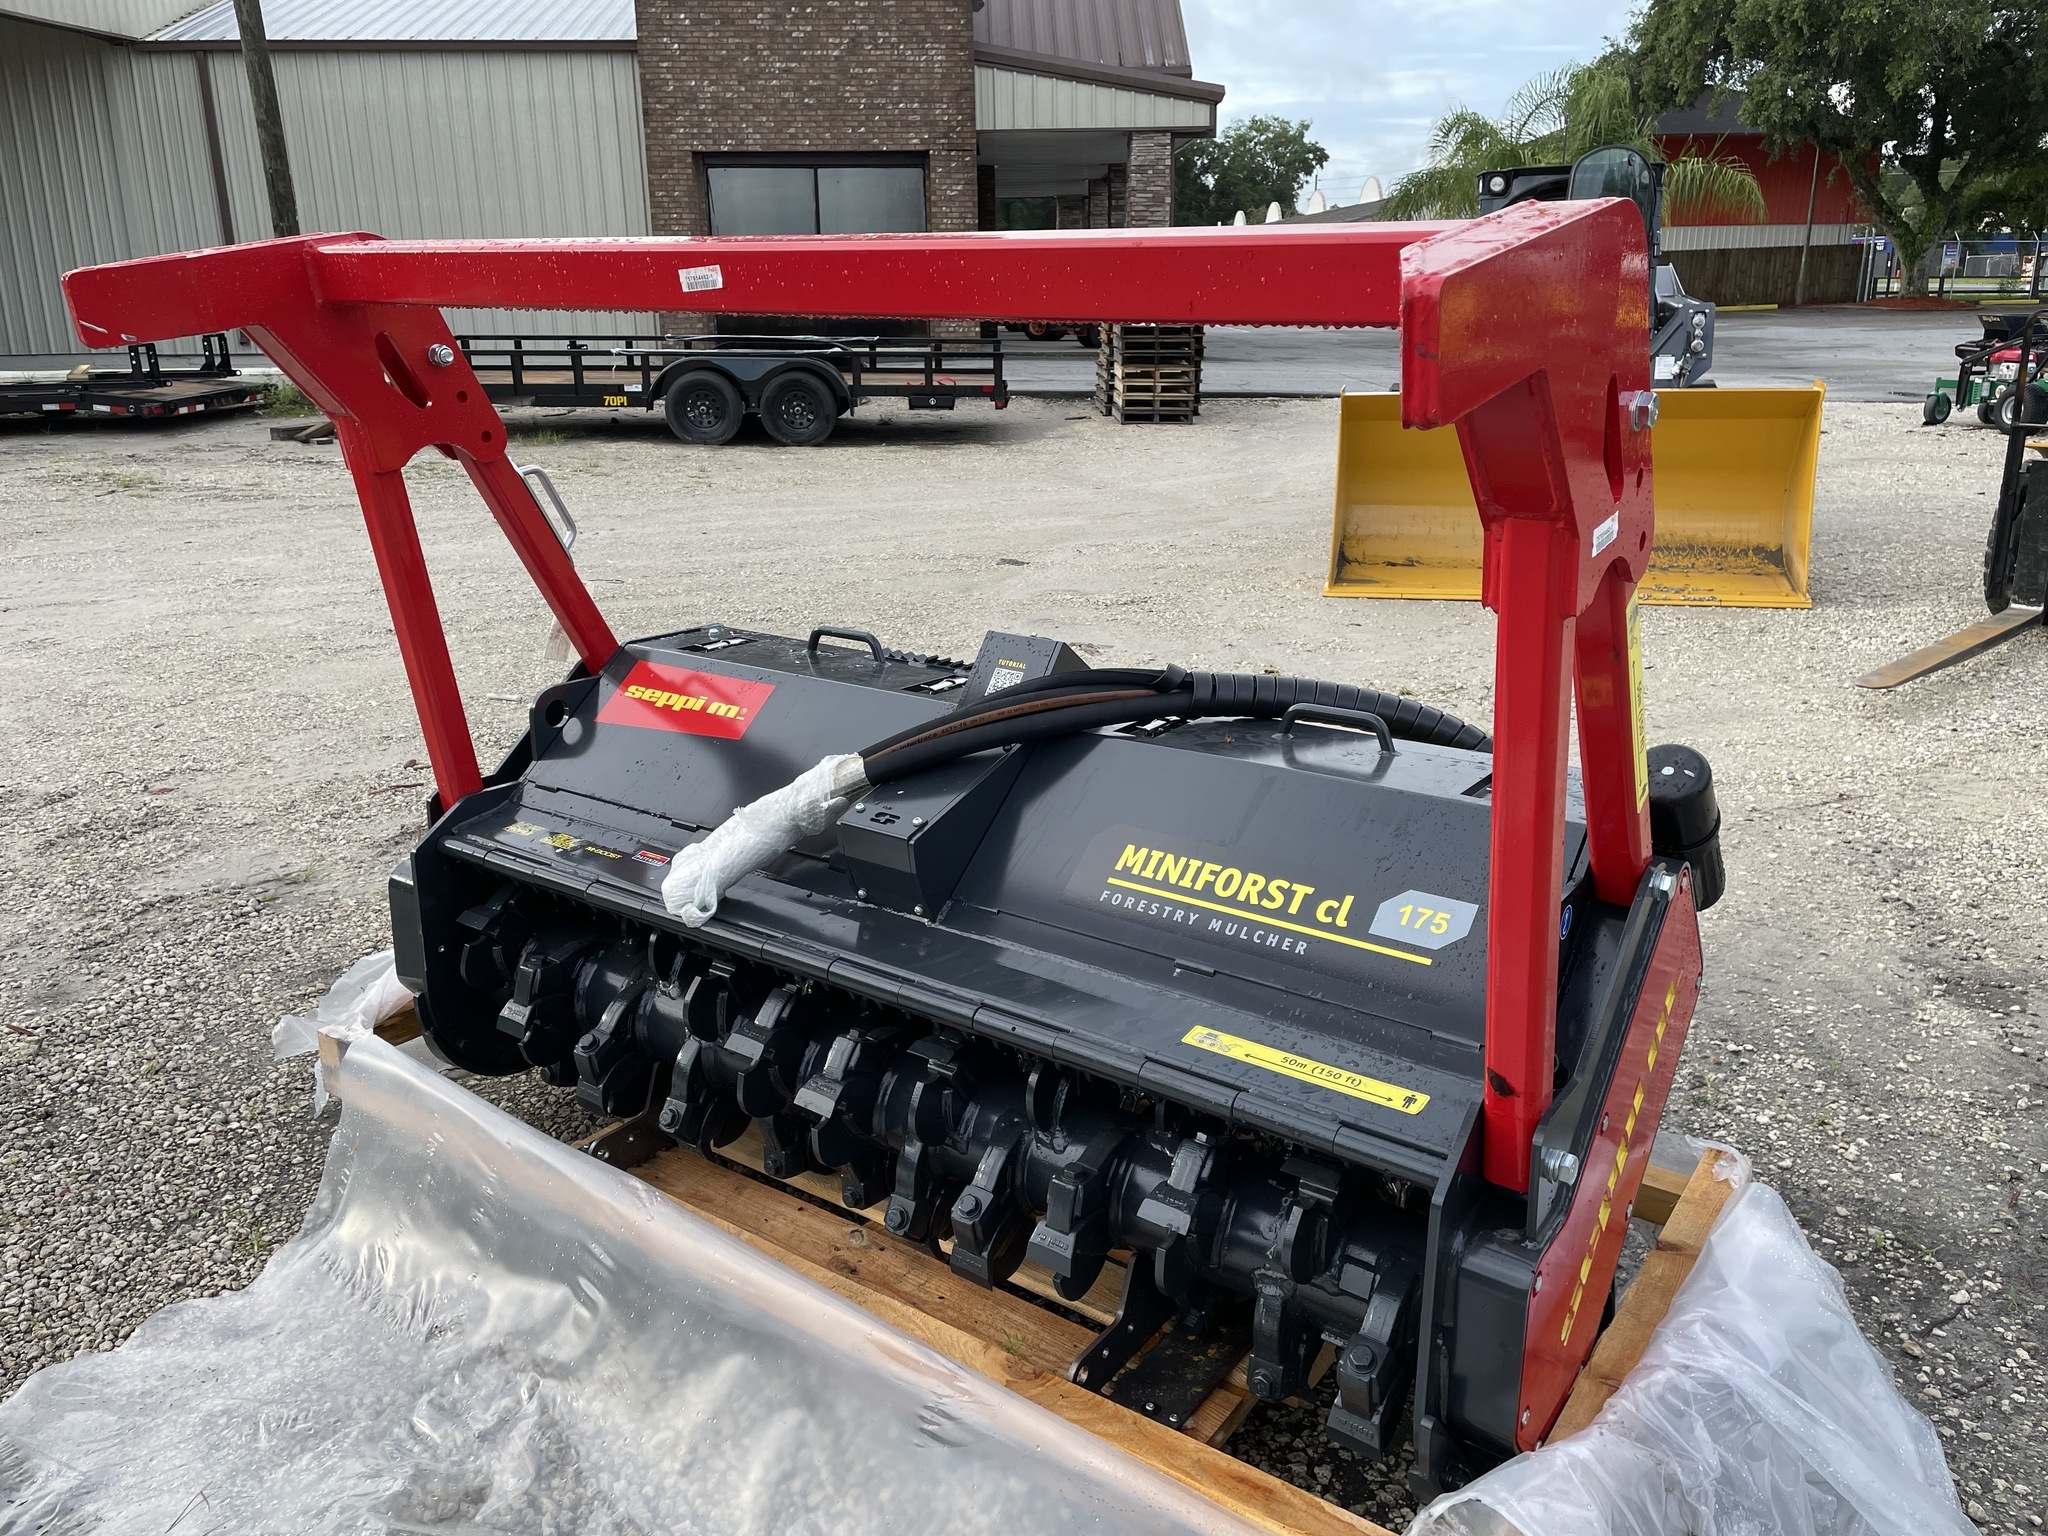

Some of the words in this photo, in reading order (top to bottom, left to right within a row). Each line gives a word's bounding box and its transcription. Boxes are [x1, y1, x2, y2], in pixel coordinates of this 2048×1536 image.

[603, 395, 628, 406] 70PI
[998, 659, 1026, 669] TUTORIAL
[623, 684, 708, 711] seppi
[1114, 843, 1315, 916] MINIFORST
[1315, 894, 1355, 928] cl
[1099, 889, 1199, 926] FORESTRY
[1207, 918, 1308, 956] MULCHER
[1398, 904, 1451, 936] 175
[1280, 1056, 1308, 1069] 50m
[1311, 1065, 1342, 1080] (150
[1345, 1075, 1362, 1087] ft)
